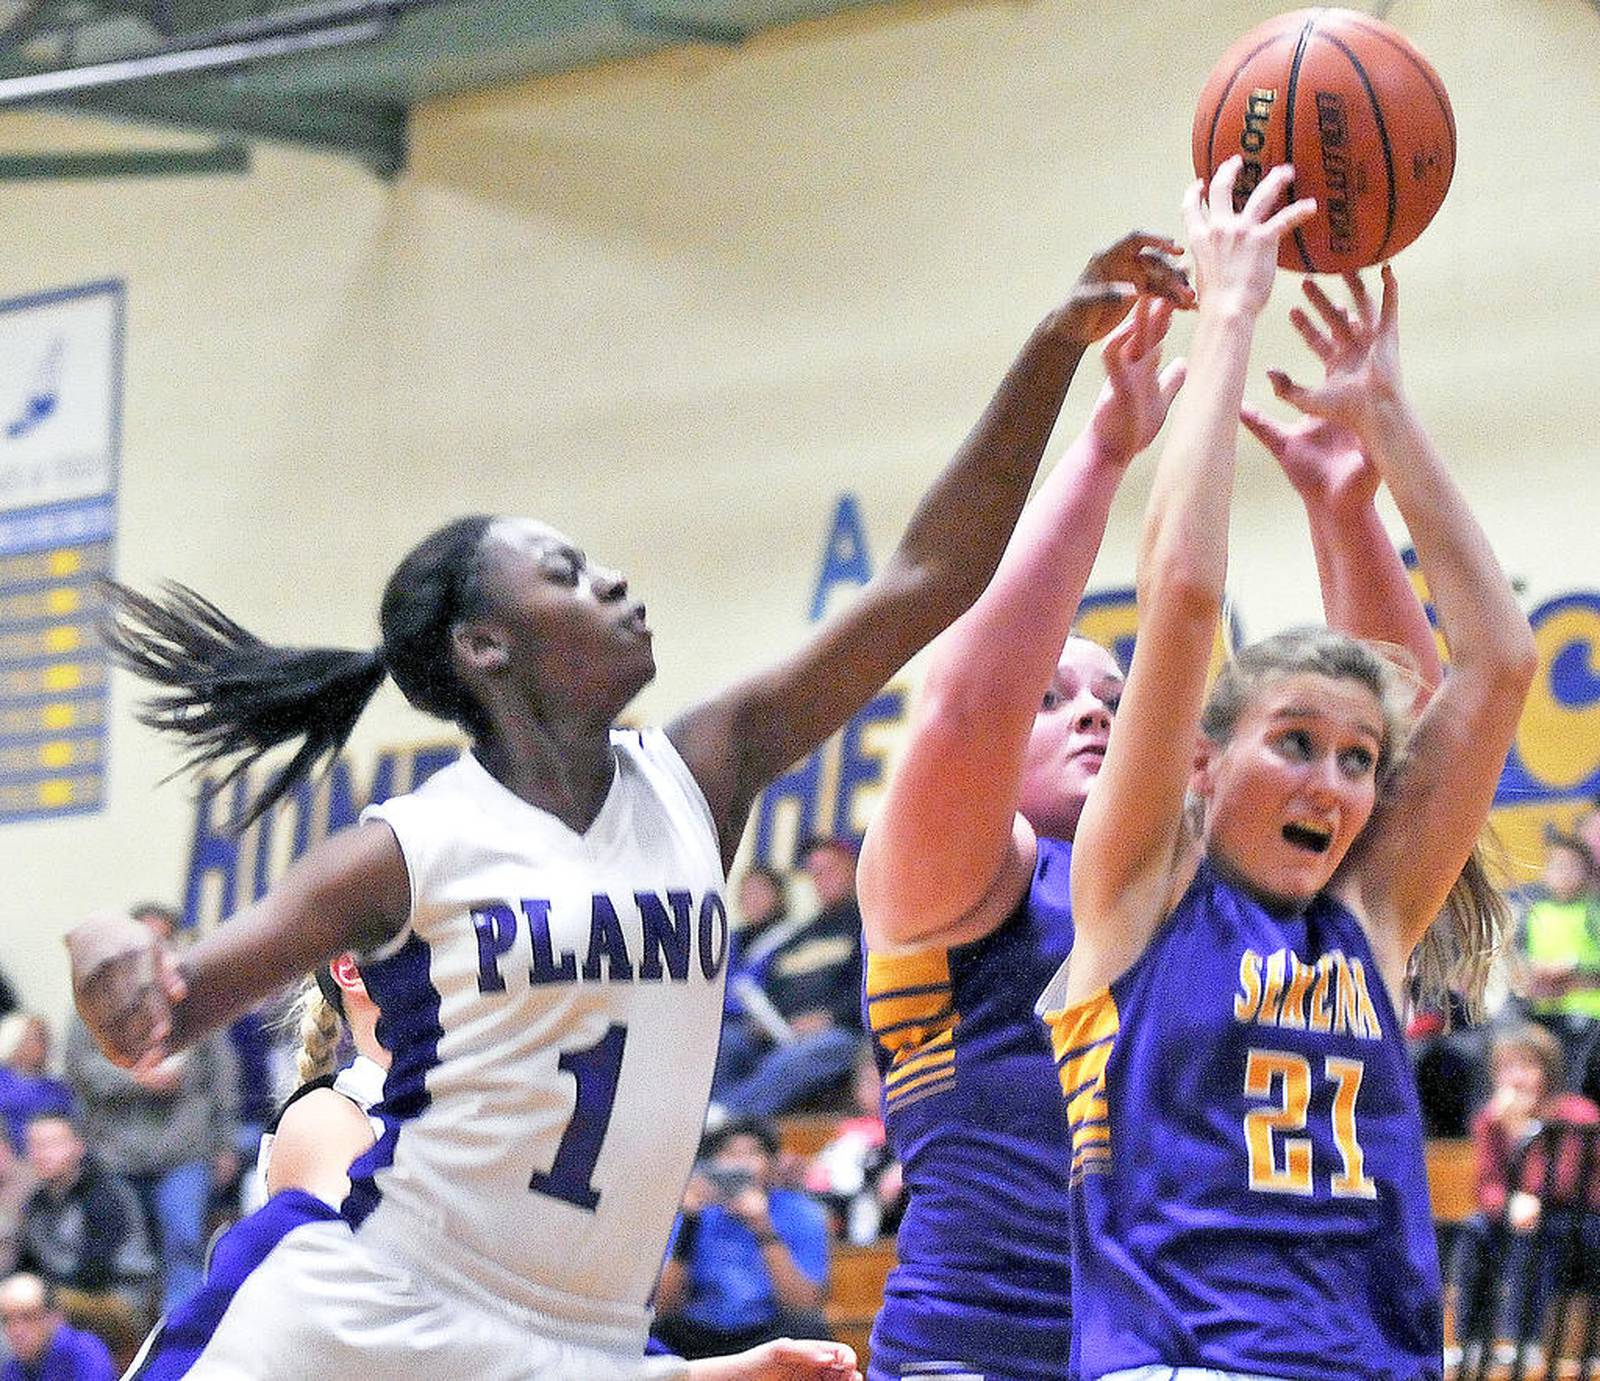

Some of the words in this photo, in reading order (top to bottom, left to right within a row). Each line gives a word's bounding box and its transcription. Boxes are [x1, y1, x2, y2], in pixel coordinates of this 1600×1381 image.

[470, 888, 728, 994] PLANO
[529, 1022, 628, 1213] 1
[1244, 1049, 1377, 1200] 21
